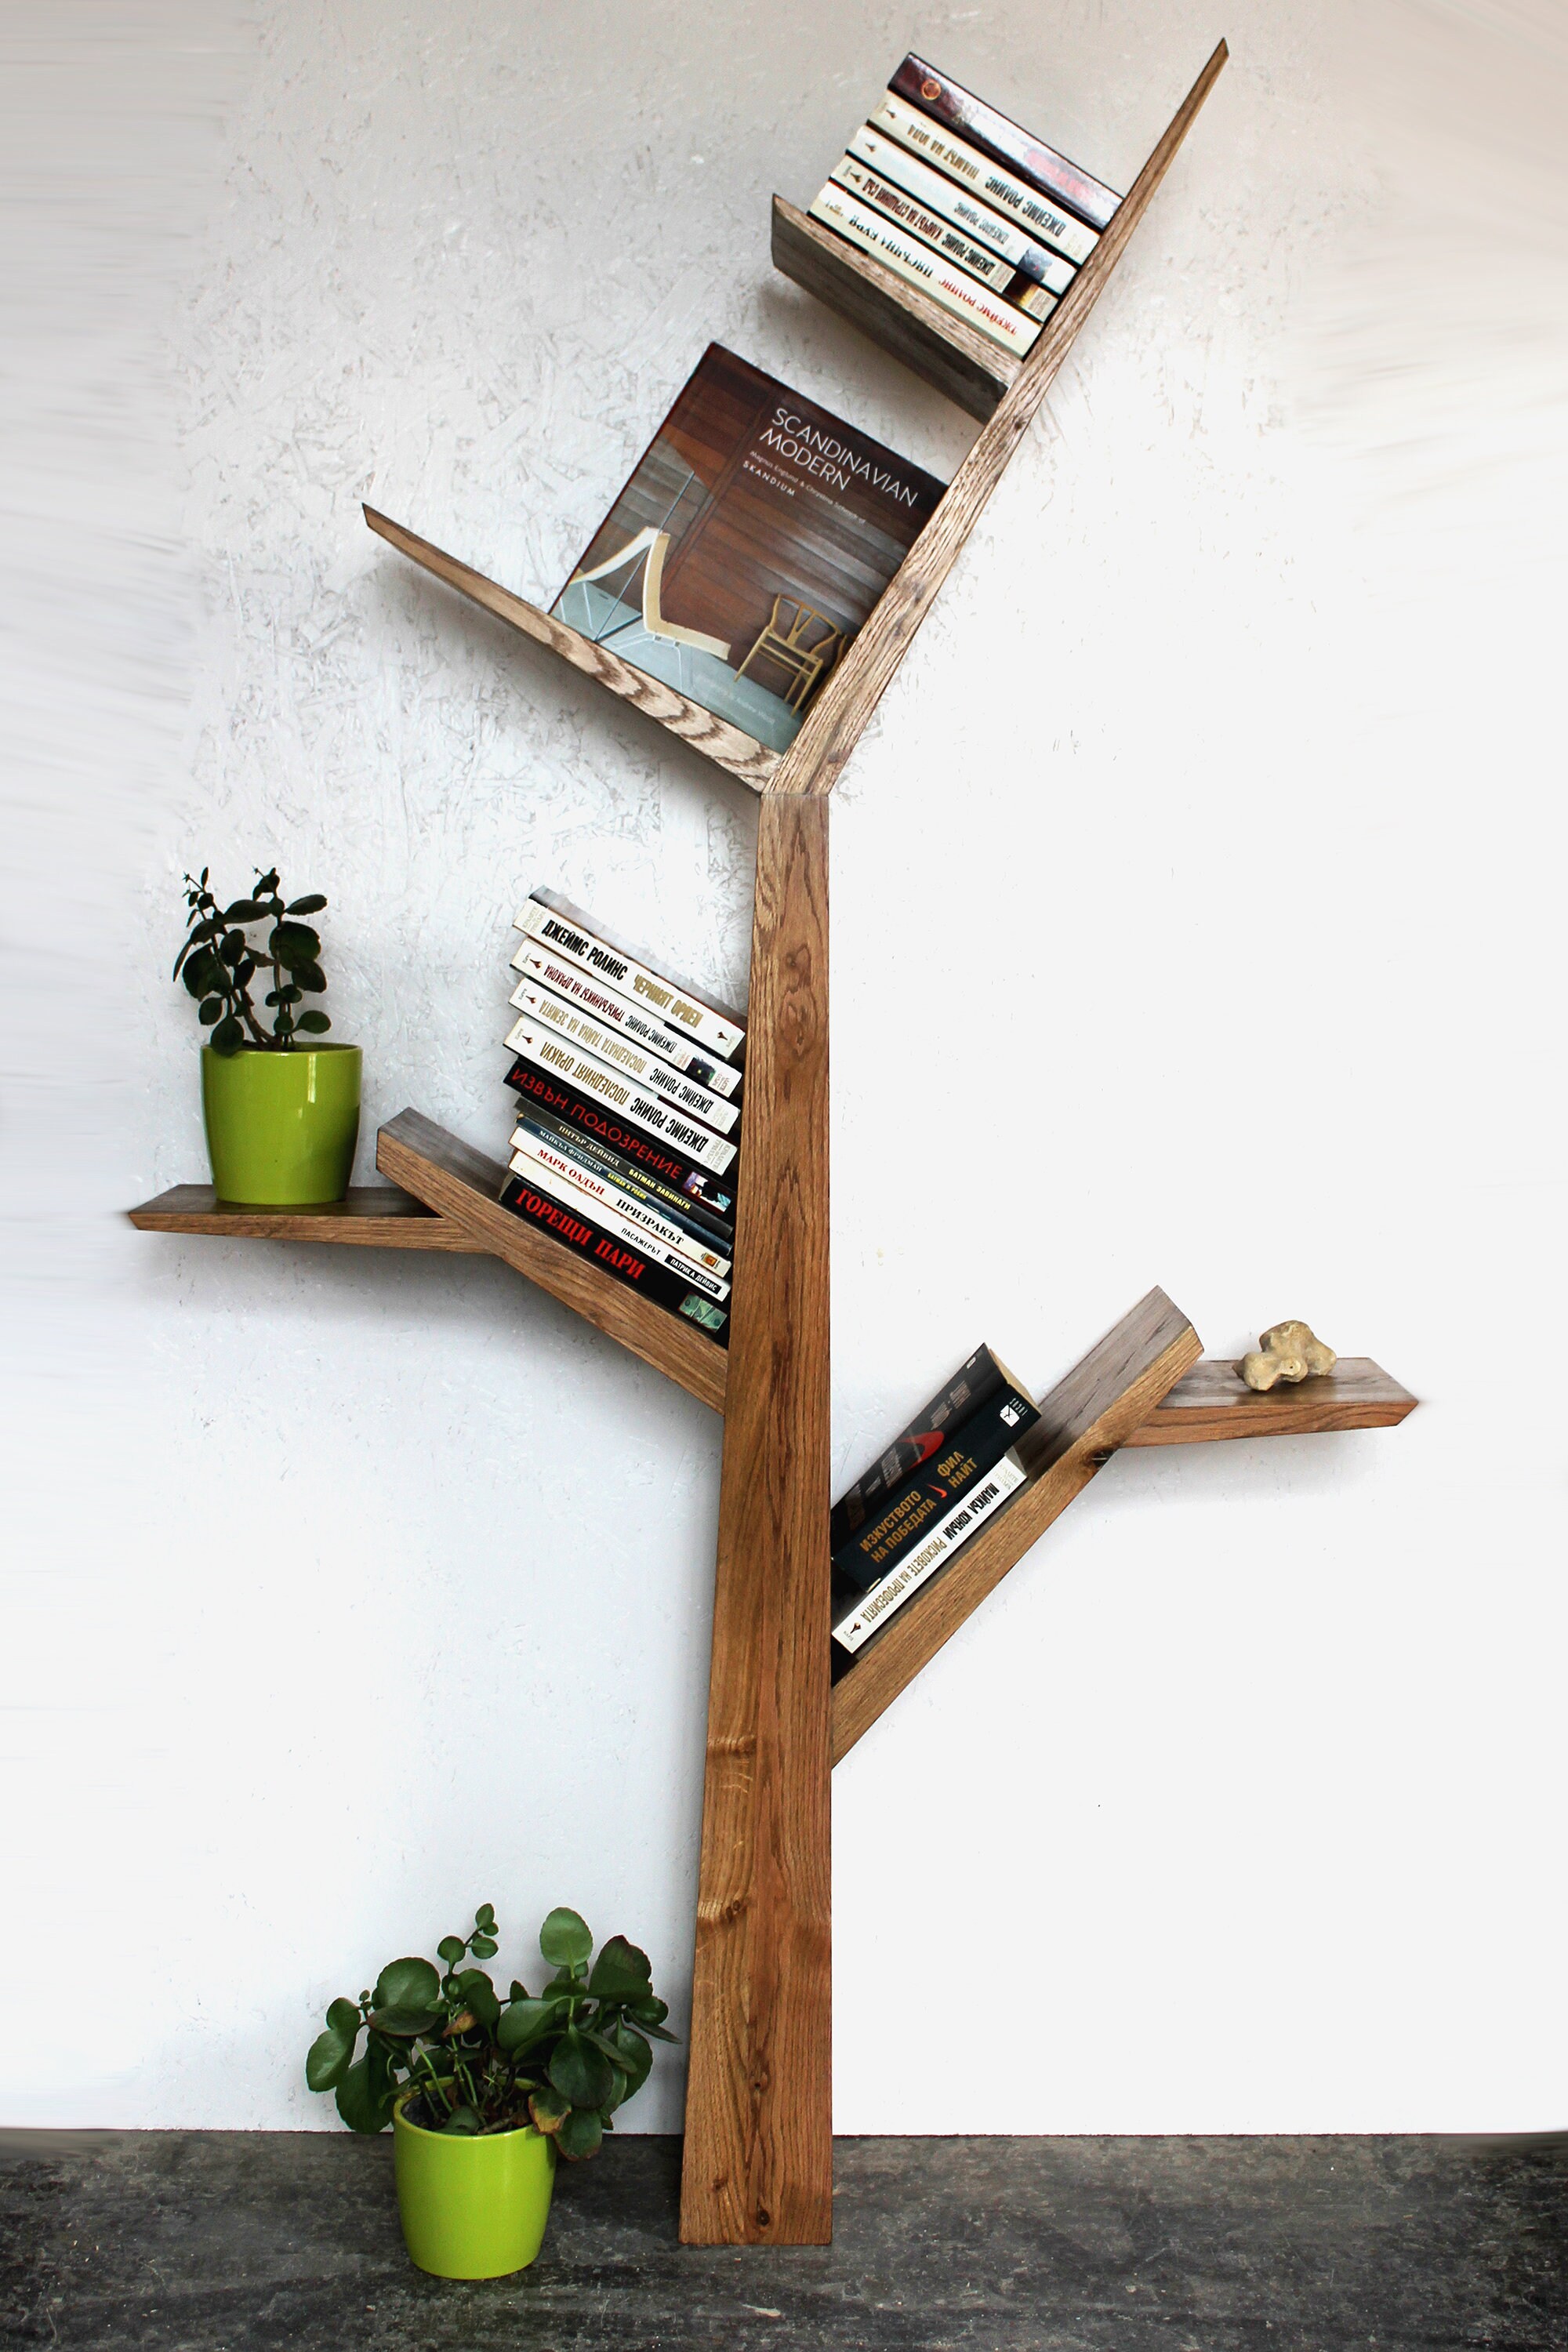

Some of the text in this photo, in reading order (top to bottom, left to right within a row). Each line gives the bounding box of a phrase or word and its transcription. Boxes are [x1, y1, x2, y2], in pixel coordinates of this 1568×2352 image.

[861, 177, 880, 197] СЪД
[984, 176, 1024, 209] РОЛИНС
[848, 217, 878, 241] БУРЯ
[905, 207, 919, 223] НА
[913, 214, 942, 241] КЛЮЧЪТ
[940, 232, 969, 258] РОЛИНС
[963, 248, 996, 276] ДЖЕЙМС
[938, 279, 976, 307] РОЛИНС
[759, 427, 851, 491] MODERN
[771, 407, 918, 507] SCANDINAVIAN
[742, 459, 795, 496] SKANDIUM
[540, 918, 590, 956] ДЖЕЙМС
[585, 946, 628, 981] РОЛИНС
[632, 973, 674, 1010] ЧЕРНИЯТ
[670, 999, 704, 1029] ОРДЕН
[538, 999, 569, 1026] ЗЕМЯТА
[543, 964, 677, 1054] ДЖЕЙМС РОЛИНС ТРИЪГЪЛНИКЪТ НА ДРАКОНА
[565, 1015, 580, 1033] НА
[576, 1022, 603, 1047] ТАЙНА
[539, 1040, 575, 1072] ОРАКУЛ
[600, 1036, 648, 1073] ПОСЛЕДНАТА
[571, 1062, 630, 1105] ПОСЛЕДНИЯТ
[648, 1067, 681, 1094] РОЛИНС
[629, 1096, 668, 1129] РОЛИНС
[677, 1084, 714, 1114] ДЖЕЙМС
[511, 1068, 568, 1110] ИЗВЪН
[569, 1103, 682, 1180] ПОДОЗРЕНИЕ
[664, 1117, 710, 1152] ДЖЕЙМС
[539, 1130, 568, 1151] МАЙКЪЛ
[566, 1149, 602, 1173] ФРИДМАН
[607, 1172, 626, 1188] БАТМАН
[558, 1125, 691, 1210] ПИТЪР ДЕЙВИД БАТМАН ЗАВИНАГИ
[536, 1149, 684, 1245] МАРК ОЛДЪН ПРИЗРАКЪТ
[515, 1188, 645, 1279] ГОРЕЩИ ПАРИ
[620, 1227, 661, 1255] ПАСАЖЕРЪТ
[669, 1257, 692, 1275] ПАТРИК
[694, 1272, 719, 1292] ДЕЙВИС
[936, 1450, 964, 1477] ФИЛ
[947, 1457, 978, 1488] НАЙТ
[966, 1482, 1000, 1515] МАЙКЪЛ
[859, 1490, 921, 1552] ИЗКУСТВОТО
[870, 1545, 889, 1563] НА
[884, 1497, 937, 1549] ПОБЕДАТА
[941, 1508, 973, 1541] КОНЪЛИ
[906, 1536, 948, 1577] РИСКОВЕТЕ
[859, 1577, 906, 1623] ПРОФЕСИЯТА
